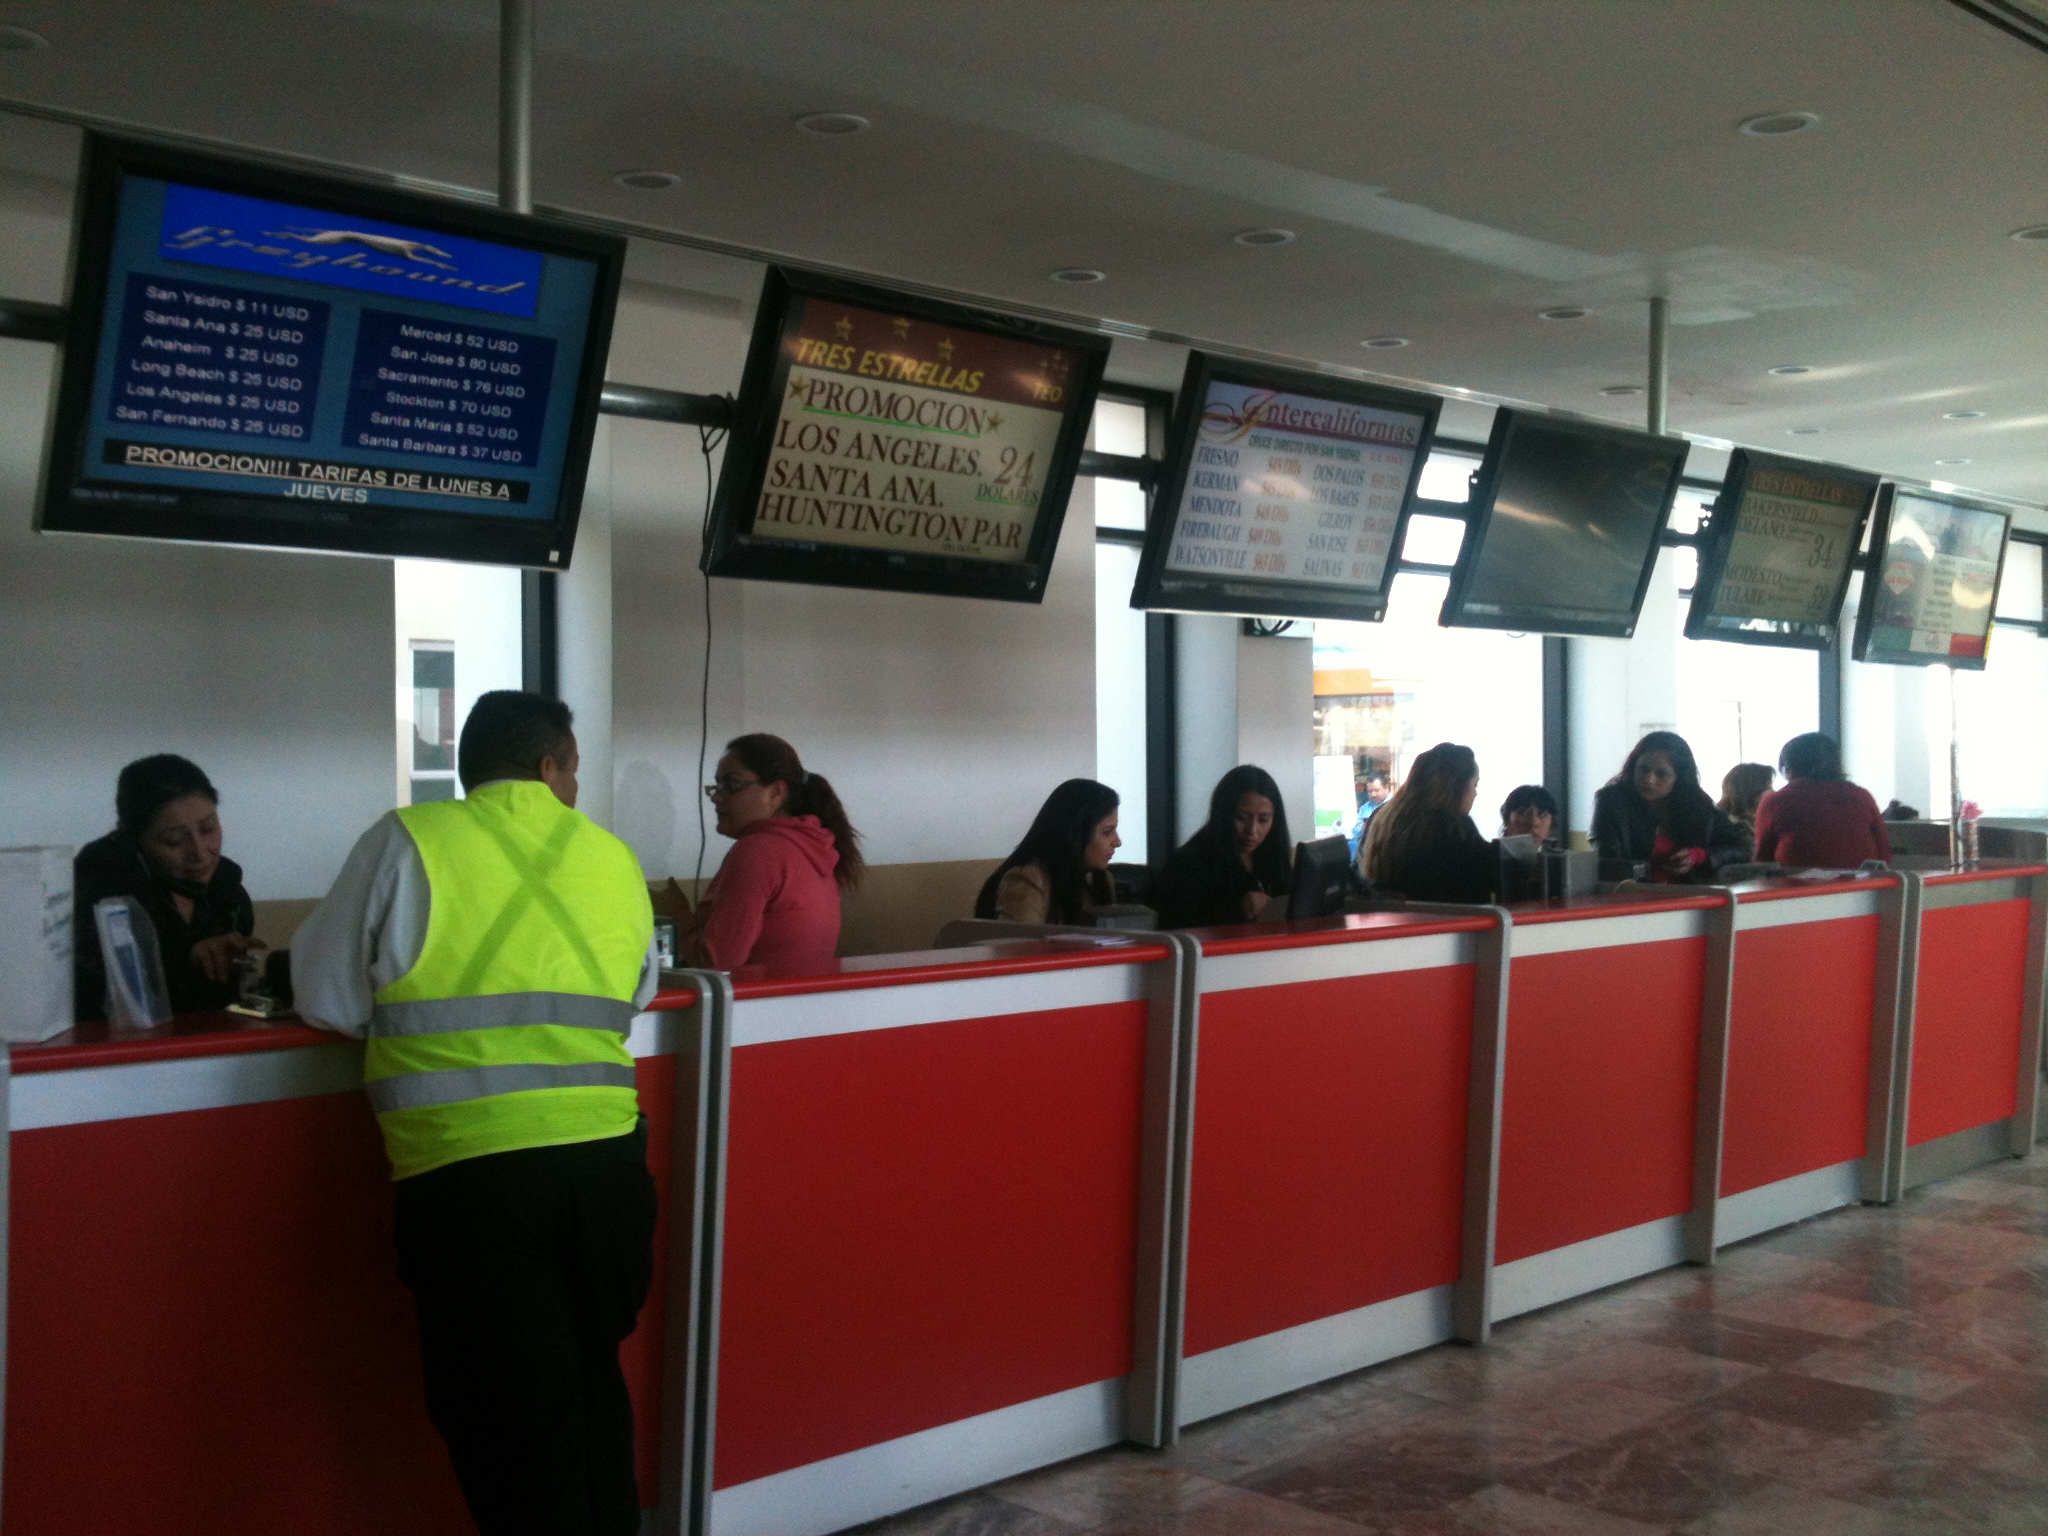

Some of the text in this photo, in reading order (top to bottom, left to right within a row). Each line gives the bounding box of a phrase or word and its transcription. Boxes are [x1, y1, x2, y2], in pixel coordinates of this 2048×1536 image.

[146, 285, 309, 321] San Ysidro $ 11 USD
[144, 310, 304, 344] Santa Ana $ 25 USD
[400, 324, 519, 353] Merced $ 52 USD
[141, 335, 299, 367] Anaheim $ 25 USD
[796, 338, 984, 393] TRES ESTRELLAS
[131, 358, 302, 390] Long Beach $ 25 USD
[378, 367, 525, 398] Sacramento $ 76 USD
[126, 382, 300, 414] Los Angeles $ 25 USD
[386, 391, 512, 418] Stockton $ 70 USD
[803, 377, 987, 434] PROMOCION
[116, 405, 303, 438] San Fernando $ 25 USD
[371, 411, 518, 440] Santa Maria $ 52 USD
[359, 433, 522, 462] Santa Barbara $ 37 USD
[776, 420, 983, 477] LOS ANGELES.
[1197, 447, 1240, 468] FRESNO
[126, 444, 510, 499] PROMOCION!!! TARIFAS DE LUNES A
[993, 446, 1035, 488] 24
[1193, 470, 1240, 492] KERMAN
[284, 482, 369, 504] JUEVES
[770, 459, 945, 508] SANTA ANA.
[757, 493, 1023, 550] HUNTINGTON PAR
[1190, 495, 1242, 518] MENDOTA
[1179, 520, 1241, 540] FIREBAUGH
[1174, 544, 1248, 570] WATSONVILLE
